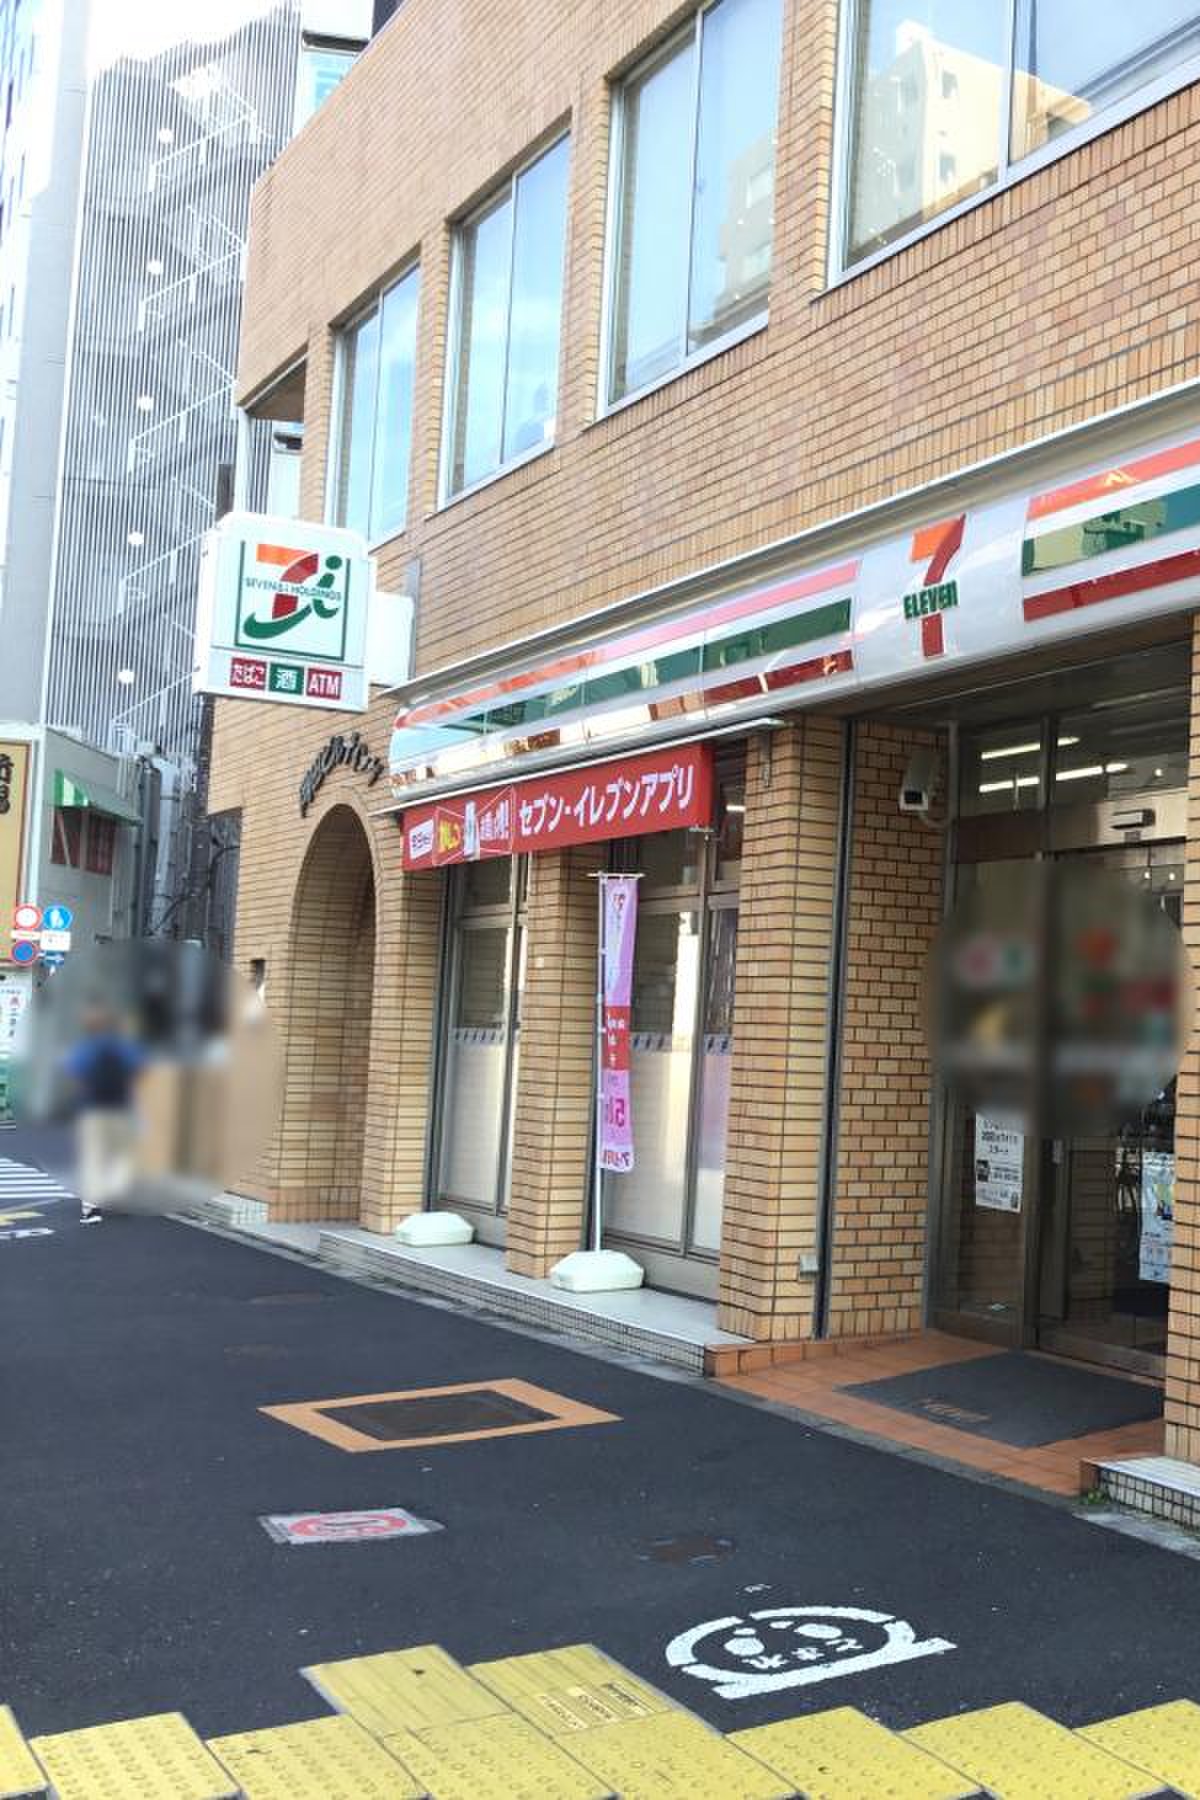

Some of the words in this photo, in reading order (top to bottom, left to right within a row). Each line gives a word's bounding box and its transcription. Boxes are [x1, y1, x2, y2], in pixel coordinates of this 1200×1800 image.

[910, 512, 966, 657] 7
[275, 668, 298, 690] 酒
[309, 673, 339, 697] ATM
